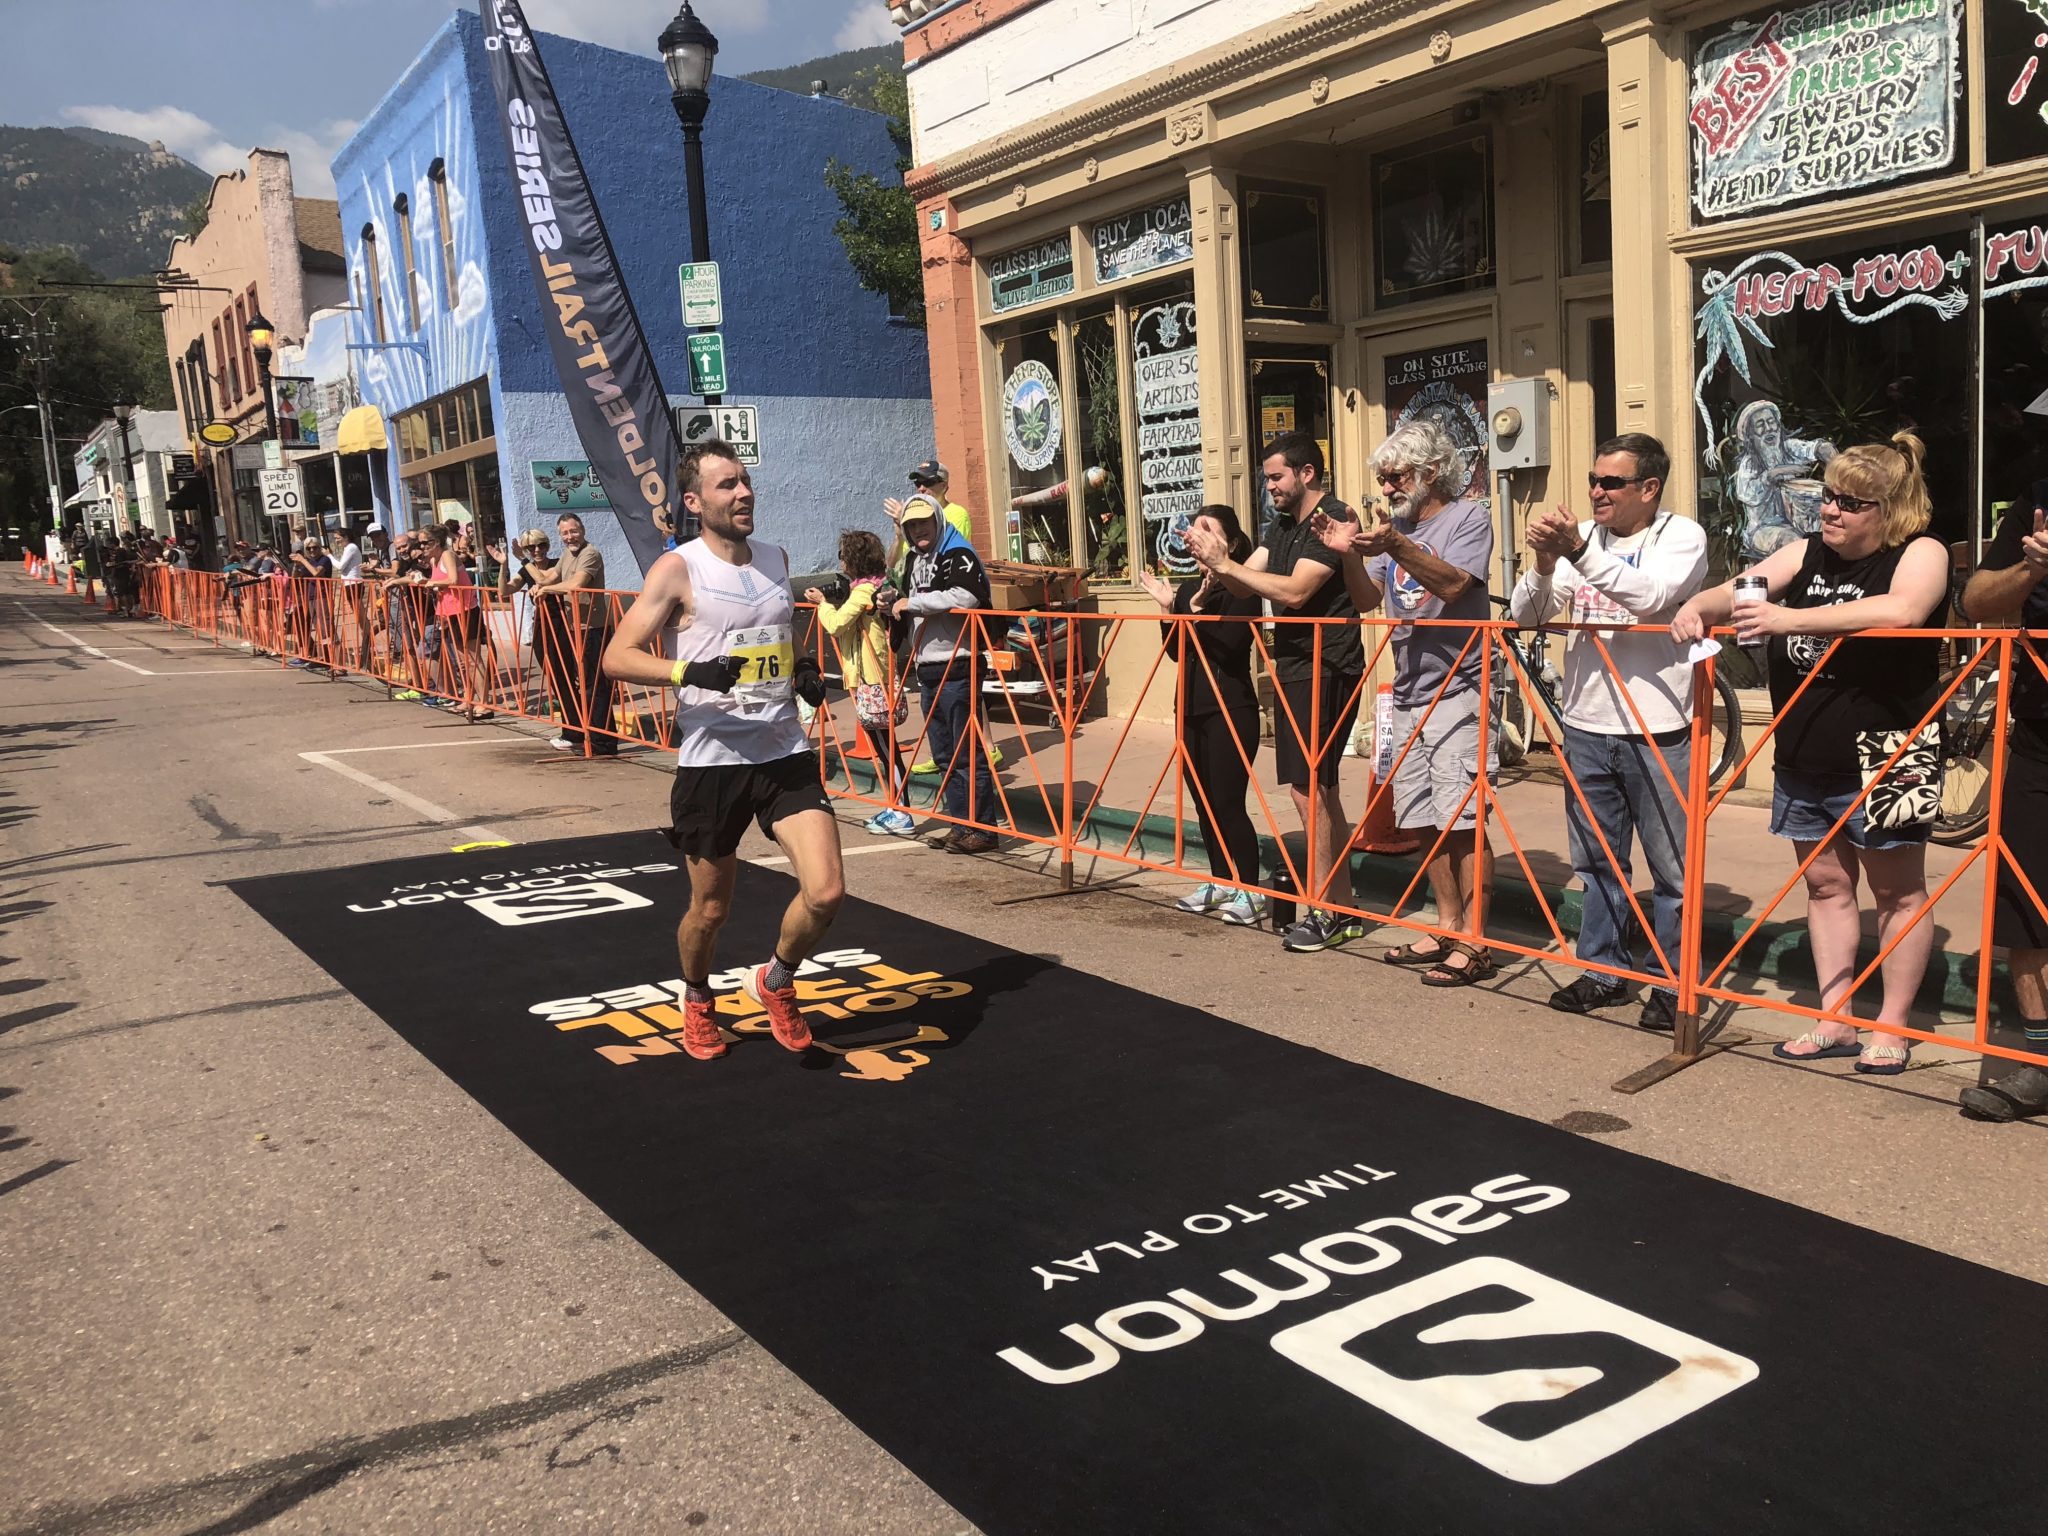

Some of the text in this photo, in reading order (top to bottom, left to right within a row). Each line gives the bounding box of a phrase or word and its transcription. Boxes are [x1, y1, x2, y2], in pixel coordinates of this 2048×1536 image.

[1781, 0, 1938, 50] SELECTION
[1828, 33, 1876, 60] AND
[1691, 16, 1791, 155] BEST
[1787, 42, 1905, 106] PRICES
[1762, 75, 1922, 143] JEWELRY
[1782, 113, 1892, 163] BEADS
[1708, 130, 1944, 209] HEMP SUPPLIES
[1098, 216, 1131, 250] BUY
[1137, 231, 1160, 244] AND
[1102, 229, 1193, 268] SAVE THE PLANET
[685, 267, 716, 279] 2 HOUR
[993, 254, 1027, 281] GLASS
[1733, 262, 1842, 318] HEMP
[1852, 245, 1945, 302] FOOD
[1985, 225, 2048, 281] FU
[684, 279, 716, 289] PARKING
[1008, 277, 1070, 305] LIVE DEMOS
[690, 344, 721, 353] RAILROAD
[1403, 350, 1470, 373] ON SITE
[1142, 354, 1198, 383] OVER 50
[1388, 361, 1488, 386] GLASS BLOWING
[1004, 363, 1061, 424] THE HEMP STORE
[1144, 382, 1199, 410] ARTISTS
[1143, 423, 1201, 447] FAIRTRAD
[734, 444, 754, 456] ARK
[263, 473, 295, 482] SPEED
[1148, 457, 1203, 480] ORGANIC
[266, 491, 298, 510] 20
[268, 483, 291, 492] LIMIT
[590, 491, 605, 500] Skin
[1050, 481, 1068, 499] RAW
[1147, 493, 1204, 515] SUSTAINAB
[1806, 585, 1834, 598] HAPP
[756, 655, 780, 680] 76
[390, 861, 609, 894] TIME TO PLAY
[1029, 1162, 1397, 1292] TIME TO PLAY
[995, 1173, 1571, 1385] salomon
